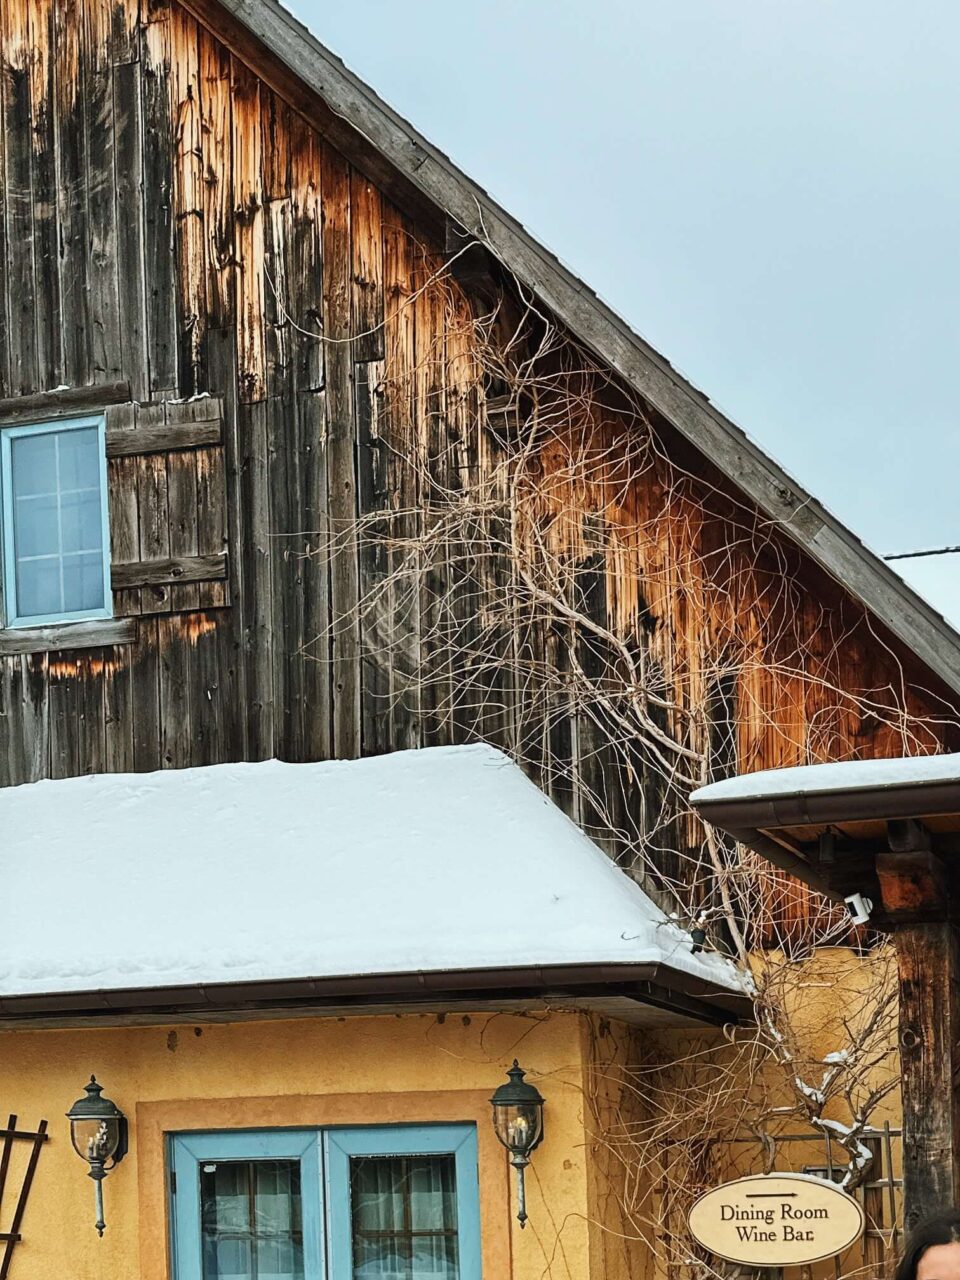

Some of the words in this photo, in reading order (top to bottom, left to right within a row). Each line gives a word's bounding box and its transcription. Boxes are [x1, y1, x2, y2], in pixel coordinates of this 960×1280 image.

[720, 1204, 775, 1224] Dining
[780, 1203, 829, 1220] Room
[736, 1226, 777, 1242] Wine
